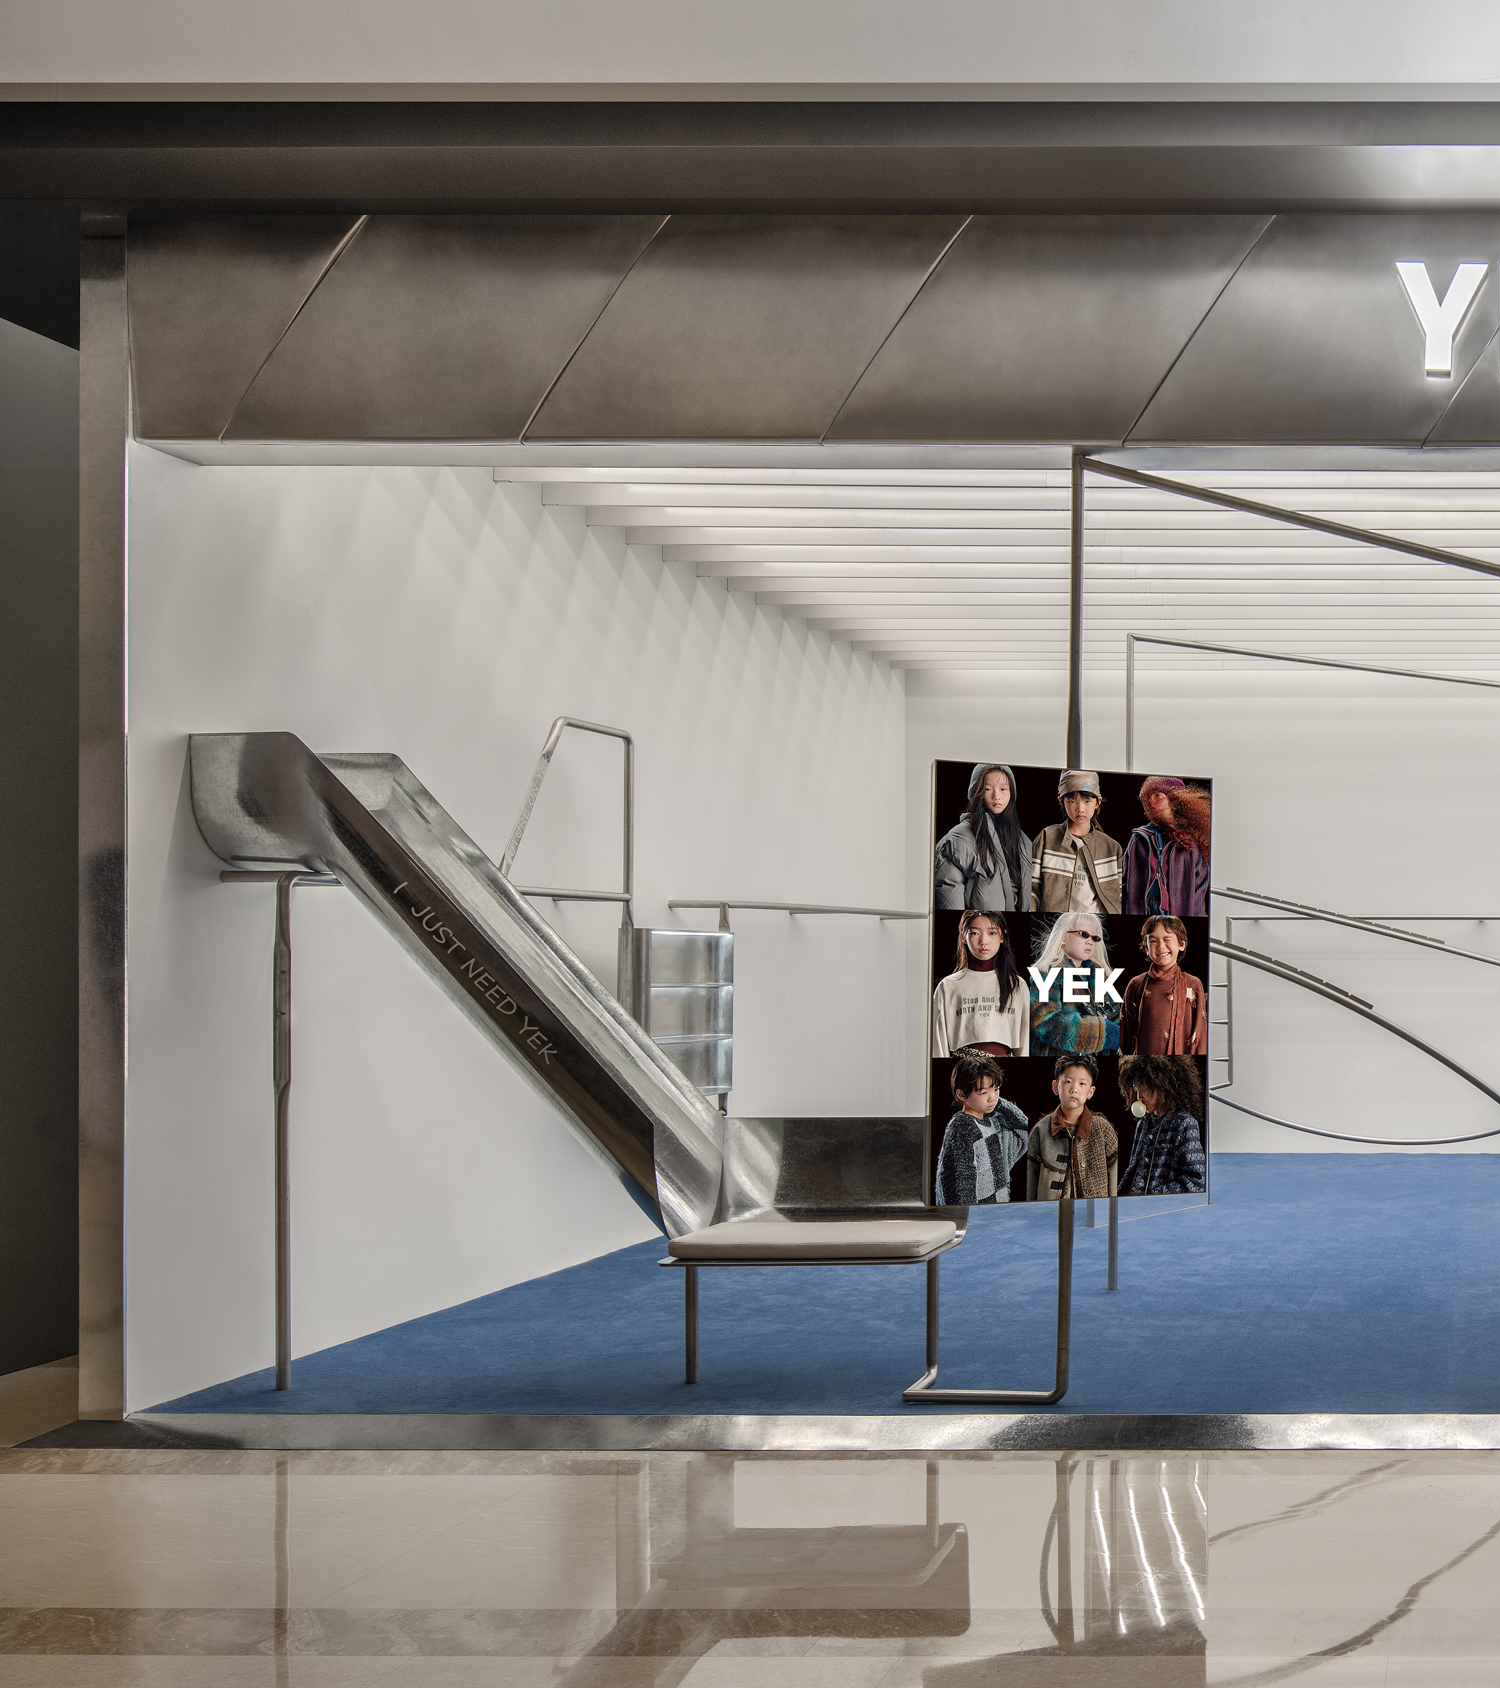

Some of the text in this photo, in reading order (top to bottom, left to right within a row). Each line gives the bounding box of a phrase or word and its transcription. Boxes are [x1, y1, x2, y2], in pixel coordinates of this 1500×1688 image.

[528, 781, 540, 806] ON
[535, 756, 552, 780] YEK
[394, 881, 558, 1065] I JUST NEED YEK
[1027, 966, 1126, 1003] YEK
[962, 997, 979, 1005] Stop
[977, 1004, 992, 1012] AND
[994, 1005, 1016, 1015] SUTH
